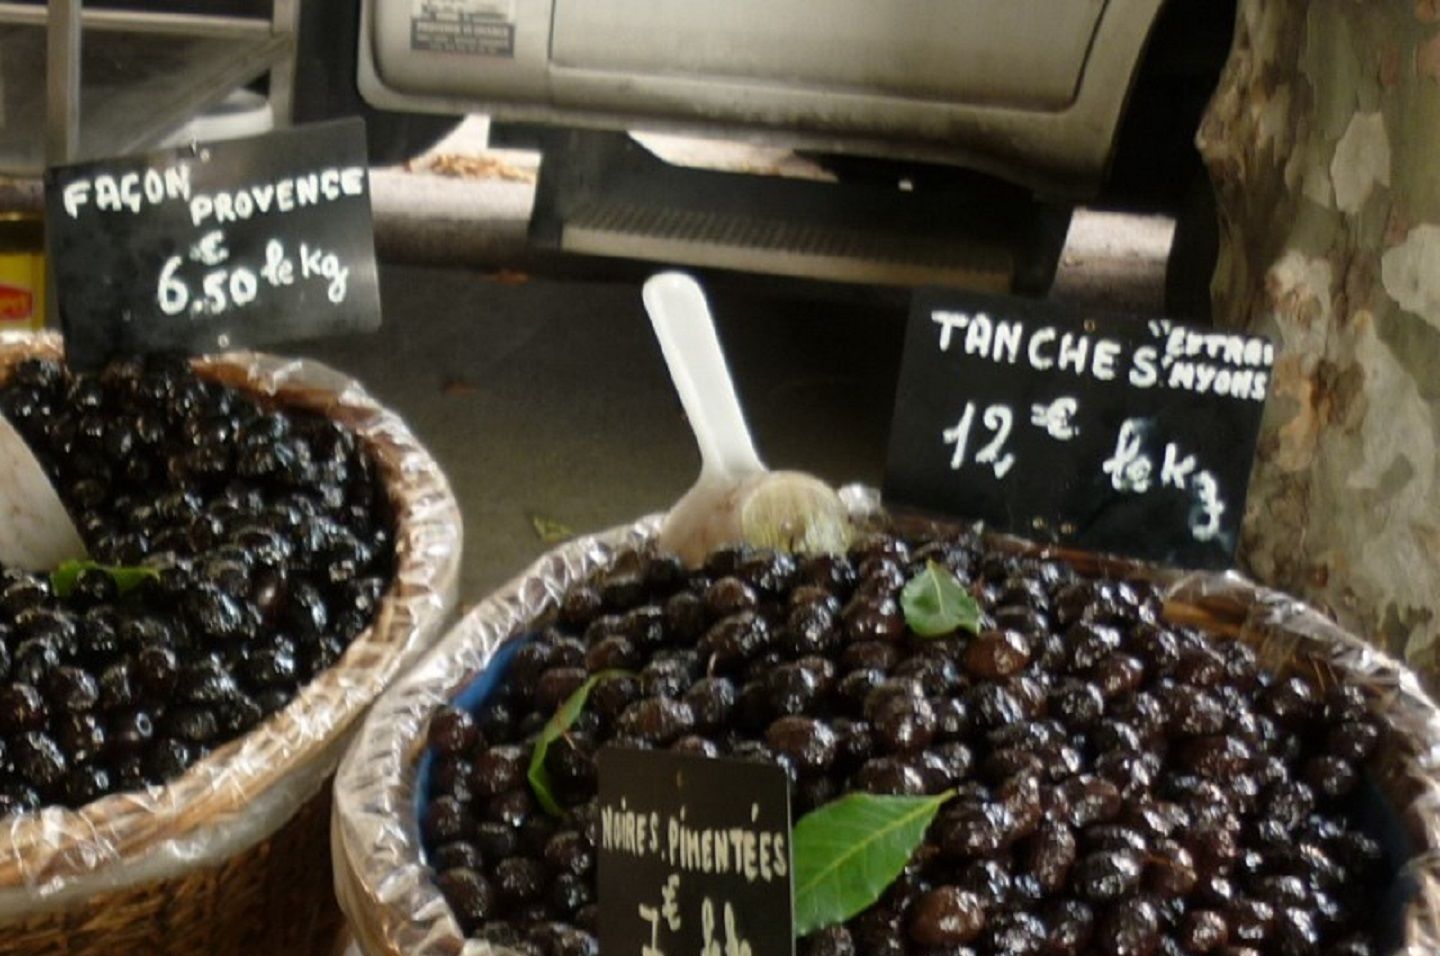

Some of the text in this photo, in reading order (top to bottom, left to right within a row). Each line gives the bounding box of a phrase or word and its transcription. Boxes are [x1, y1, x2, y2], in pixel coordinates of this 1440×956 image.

[63, 163, 365, 227] FAÇON PROVENCE
[299, 242, 349, 304] kg
[931, 310, 1158, 388] TANCHES
